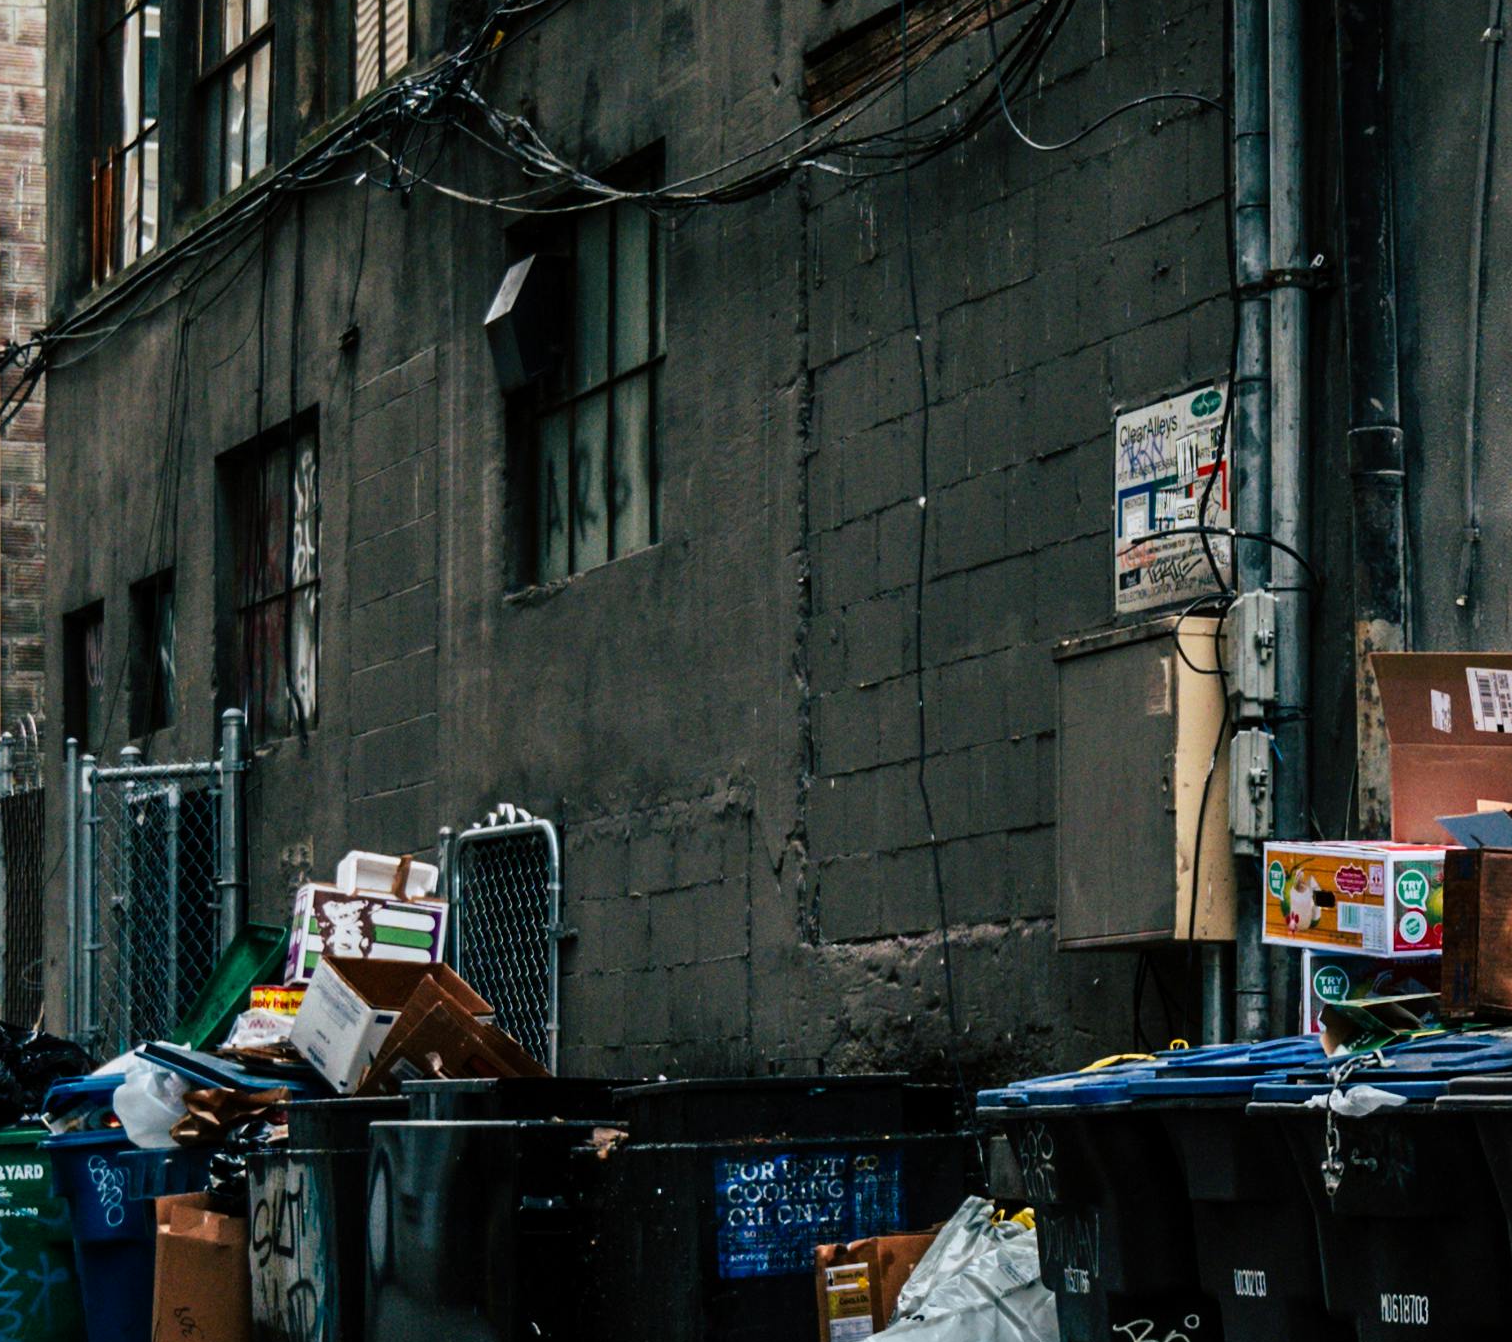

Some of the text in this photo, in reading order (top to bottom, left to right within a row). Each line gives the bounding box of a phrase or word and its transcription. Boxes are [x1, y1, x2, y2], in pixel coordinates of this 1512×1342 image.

[1120, 415, 1178, 447] ClearAlleys
[1400, 880, 1423, 890] TRY
[1404, 890, 1420, 900] ME
[1319, 976, 1343, 986] TRY
[1322, 985, 1340, 995] ME
